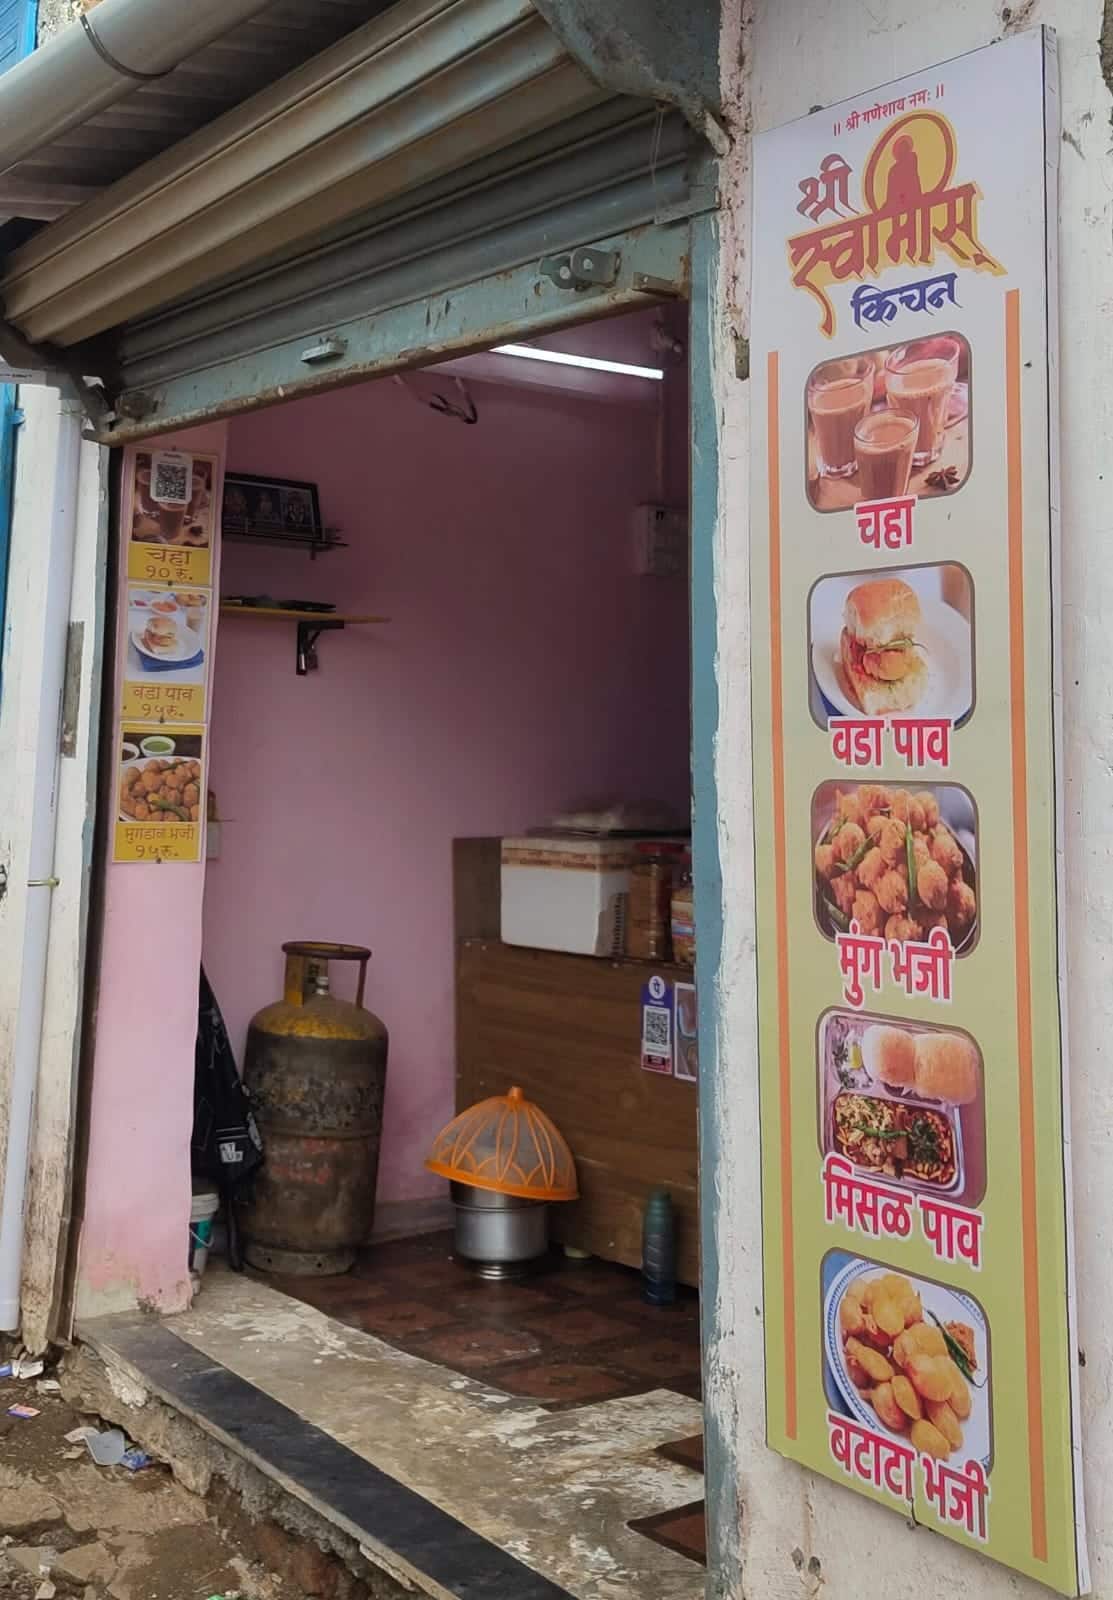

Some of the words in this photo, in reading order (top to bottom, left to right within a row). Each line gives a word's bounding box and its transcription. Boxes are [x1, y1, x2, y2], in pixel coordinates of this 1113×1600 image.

[845, 111, 860, 131] श्री
[862, 97, 907, 123] गणेशाय
[908, 89, 931, 107] नमः
[796, 153, 859, 224] श्री
[850, 272, 963, 332] किचन
[855, 498, 916, 549] चहा
[145, 548, 193, 567] चहा
[131, 686, 161, 700] वडा
[165, 687, 196, 702] पाव
[829, 719, 885, 767] वडा
[891, 718, 952, 768] पाव
[168, 824, 196, 841] भजी
[837, 922, 883, 1006] मुंग
[891, 930, 953, 1000] भजी
[823, 1156, 913, 1237] मिसळ
[919, 1200, 983, 1267] पाव
[828, 1413, 915, 1501] बटाटा
[922, 1459, 990, 1539] भजी
